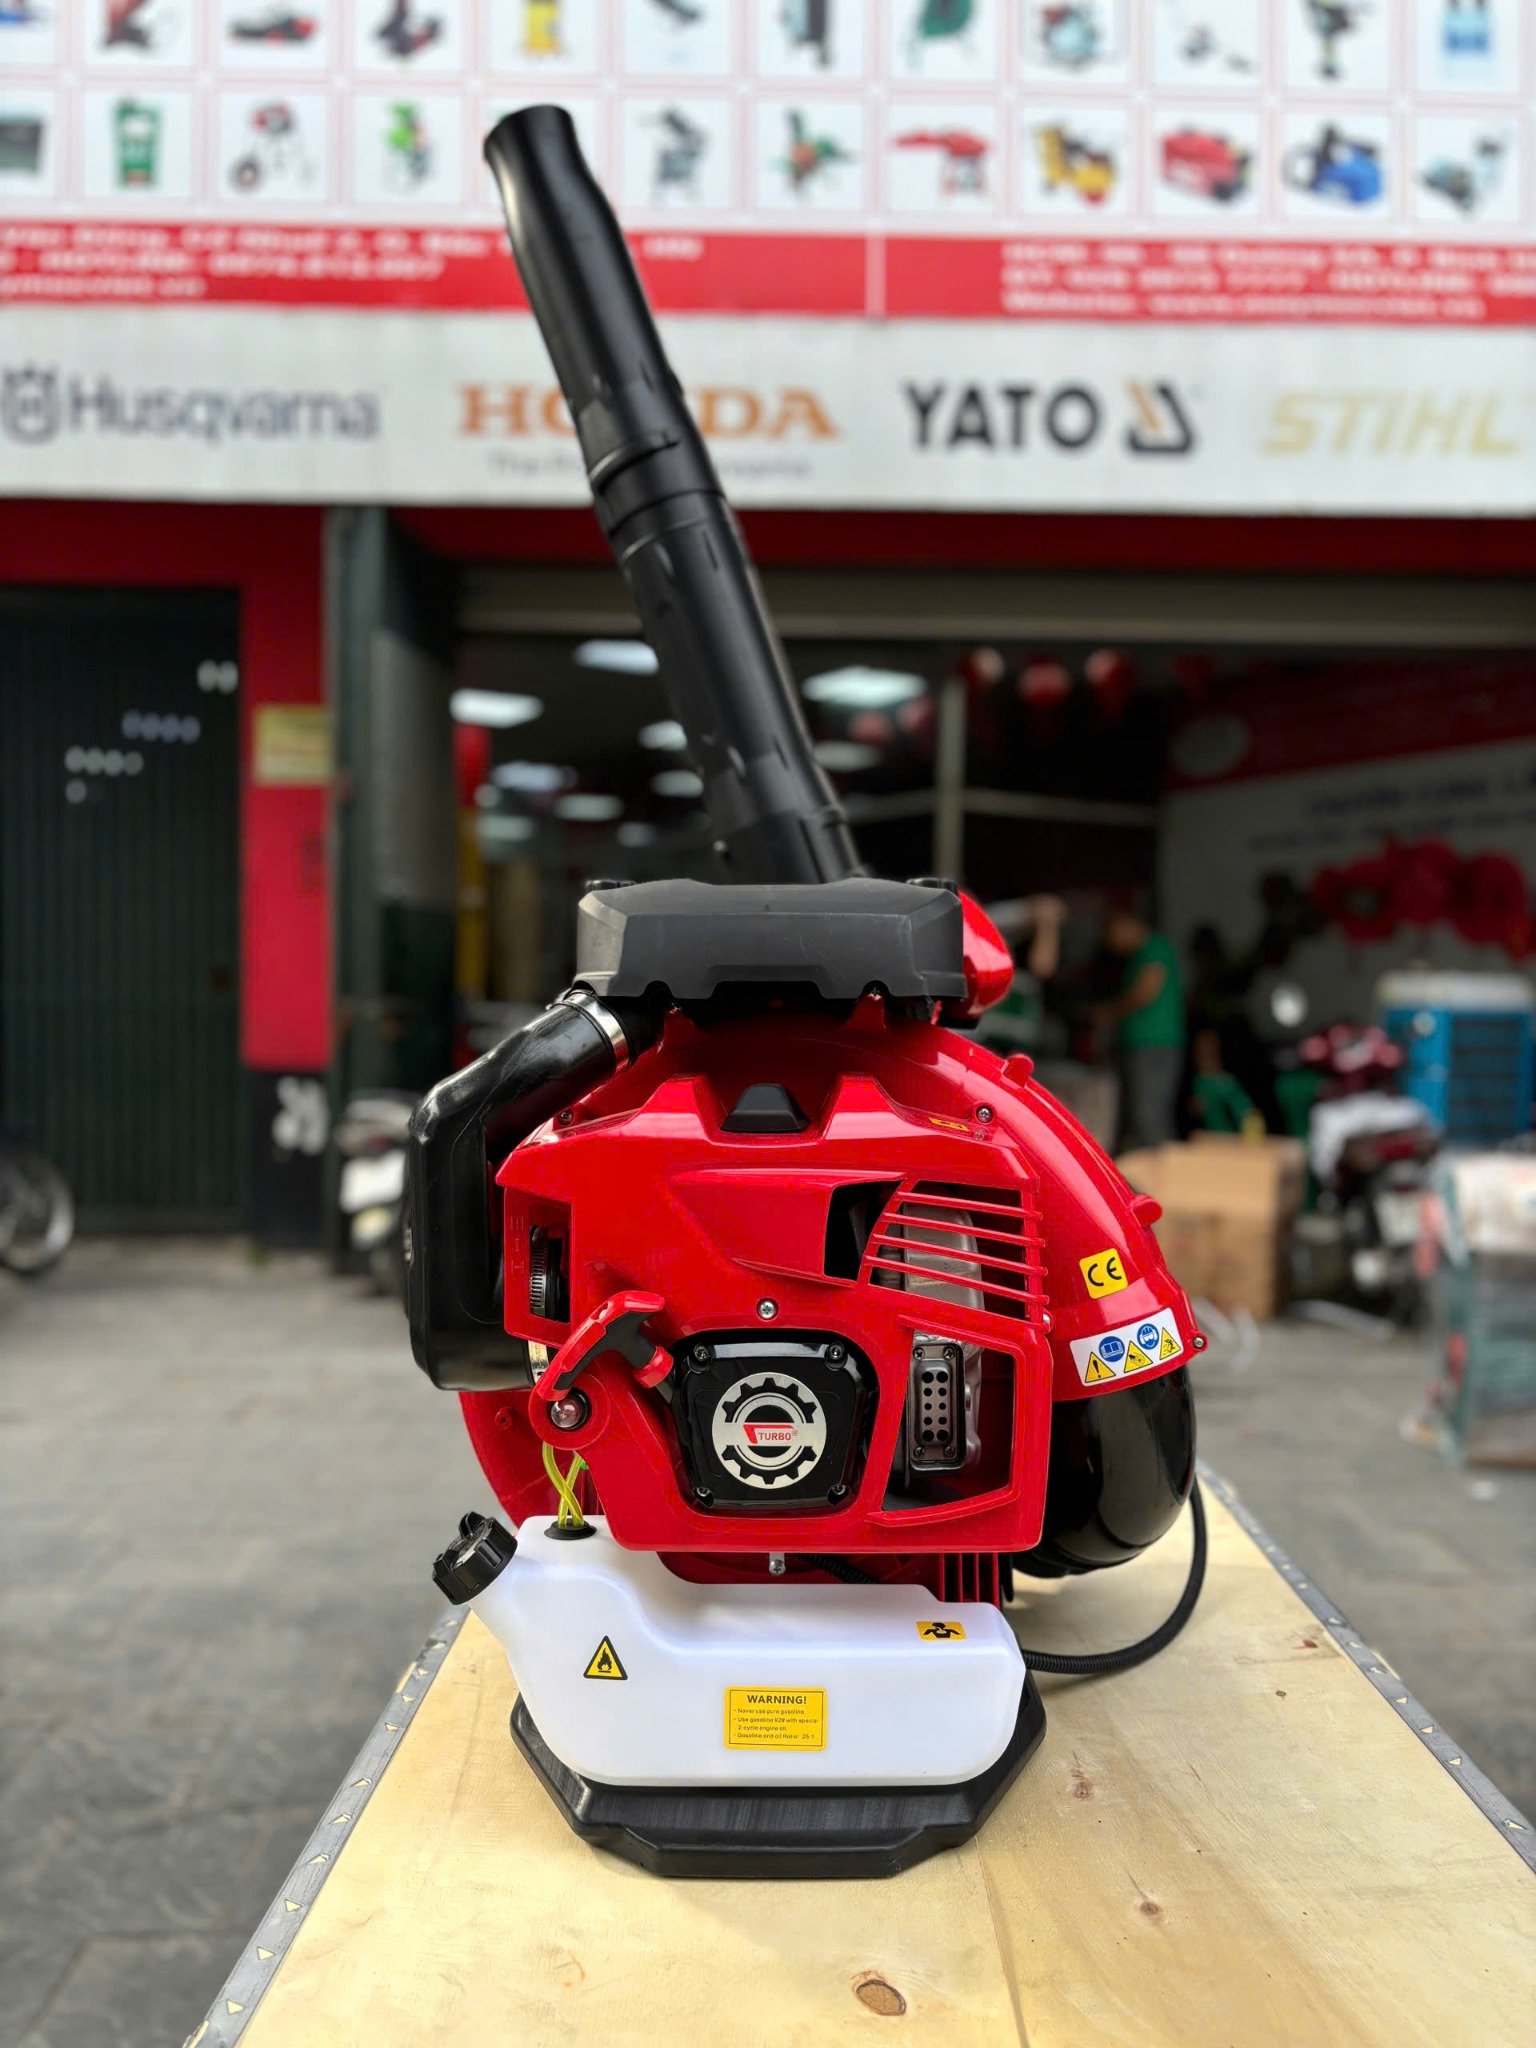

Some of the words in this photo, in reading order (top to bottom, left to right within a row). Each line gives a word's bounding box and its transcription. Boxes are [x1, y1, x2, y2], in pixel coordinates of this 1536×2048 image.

[459, 381, 838, 439] HODA
[905, 382, 1101, 448] YATO
[1260, 389, 1520, 455] STIHL
[1087, 1256, 1122, 1287] CE
[747, 1694, 807, 1704] WARNING!
